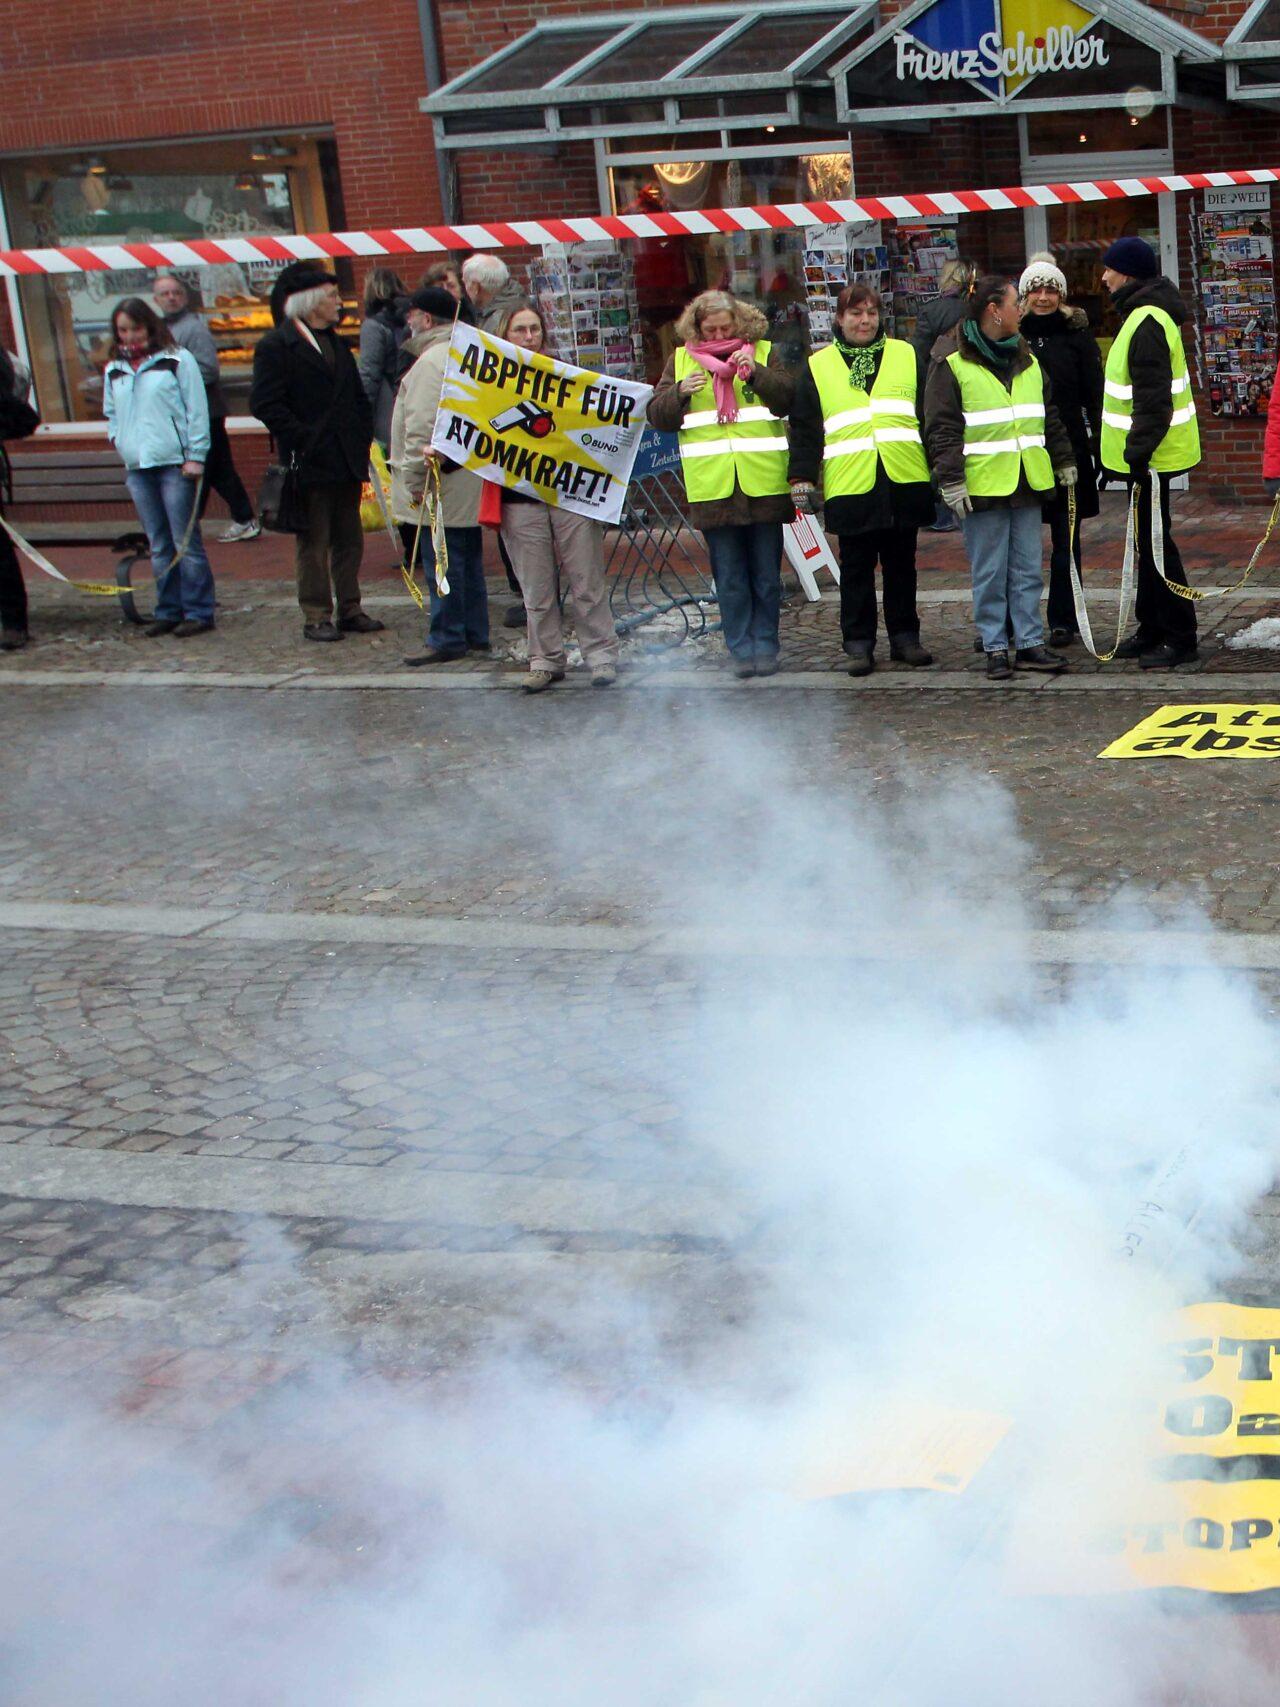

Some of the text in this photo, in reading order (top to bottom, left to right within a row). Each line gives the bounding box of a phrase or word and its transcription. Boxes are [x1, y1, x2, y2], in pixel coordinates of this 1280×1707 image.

[1207, 191, 1267, 205] DIE WELT
[459, 343, 636, 429] ABPFIFF FÜR
[445, 415, 613, 503] ATOMKRAFT!
[591, 440, 619, 454] BUND
